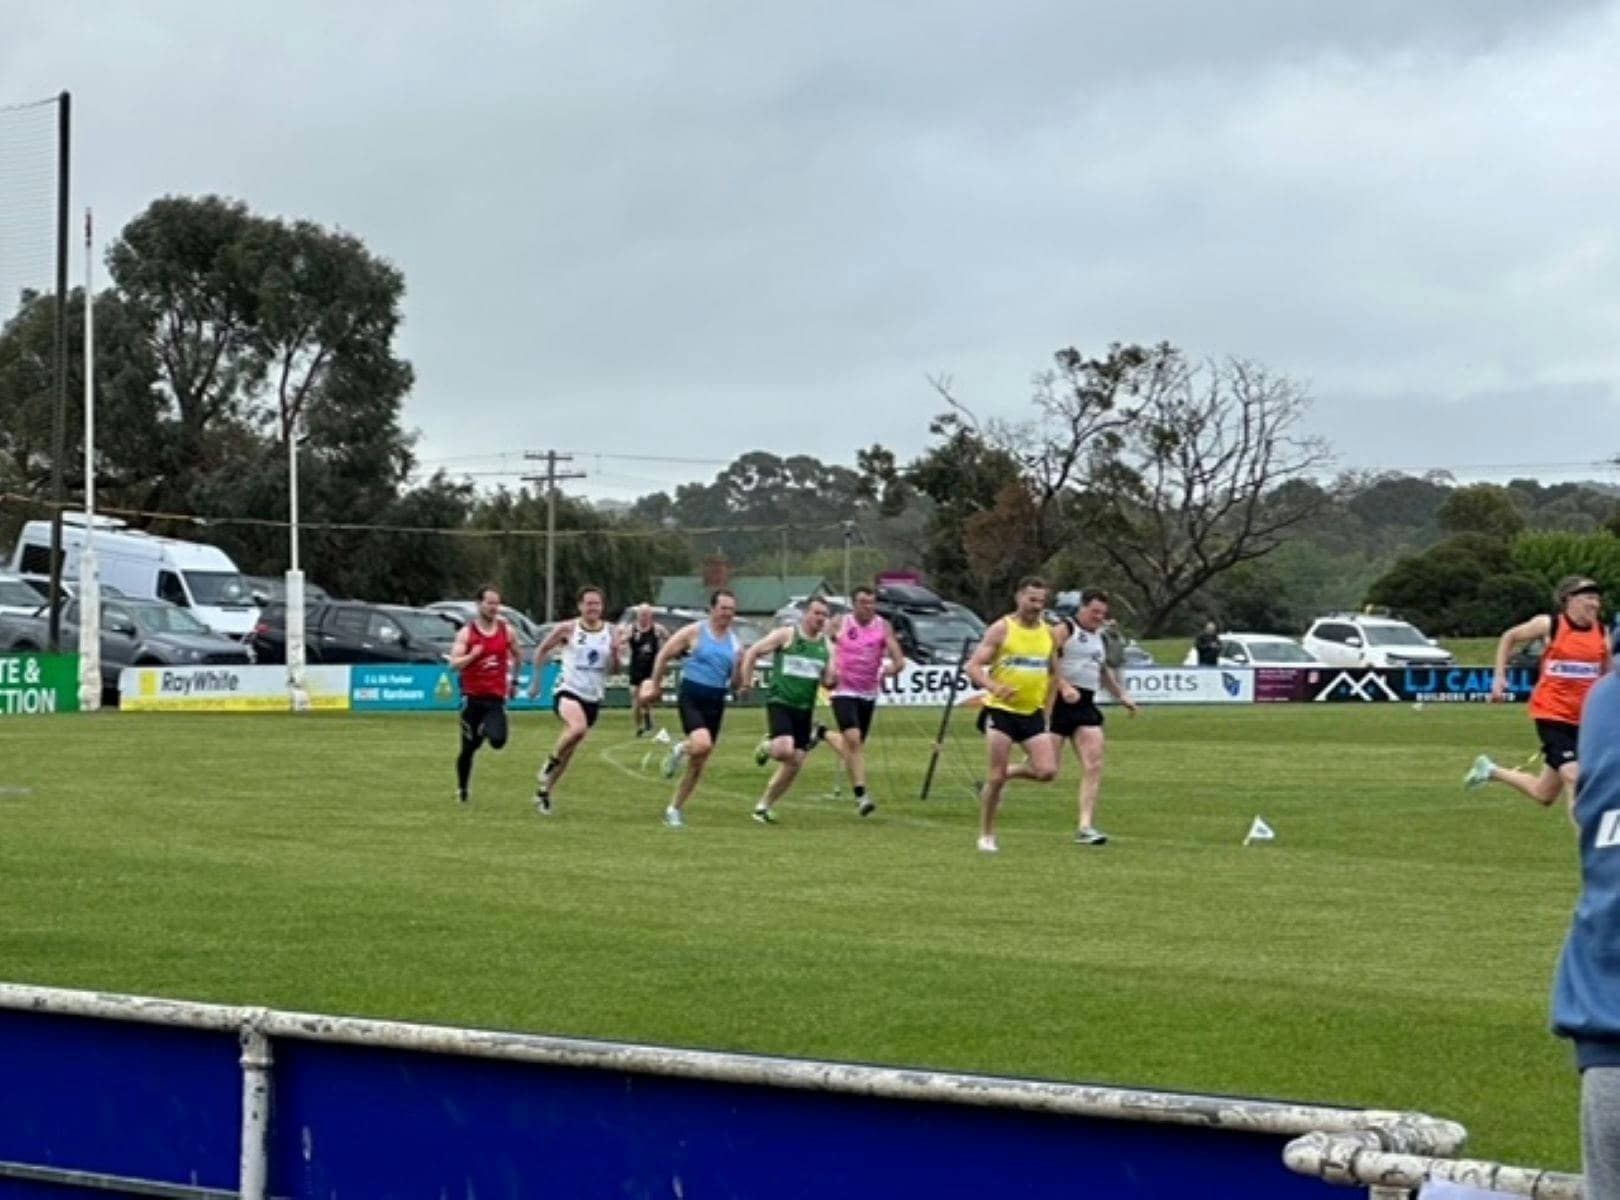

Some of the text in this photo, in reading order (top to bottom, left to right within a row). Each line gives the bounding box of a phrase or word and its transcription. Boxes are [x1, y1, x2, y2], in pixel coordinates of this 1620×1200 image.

[24, 657, 40, 683] &
[1405, 669, 1534, 691] LJ CAHLL
[0, 687, 56, 713] TION
